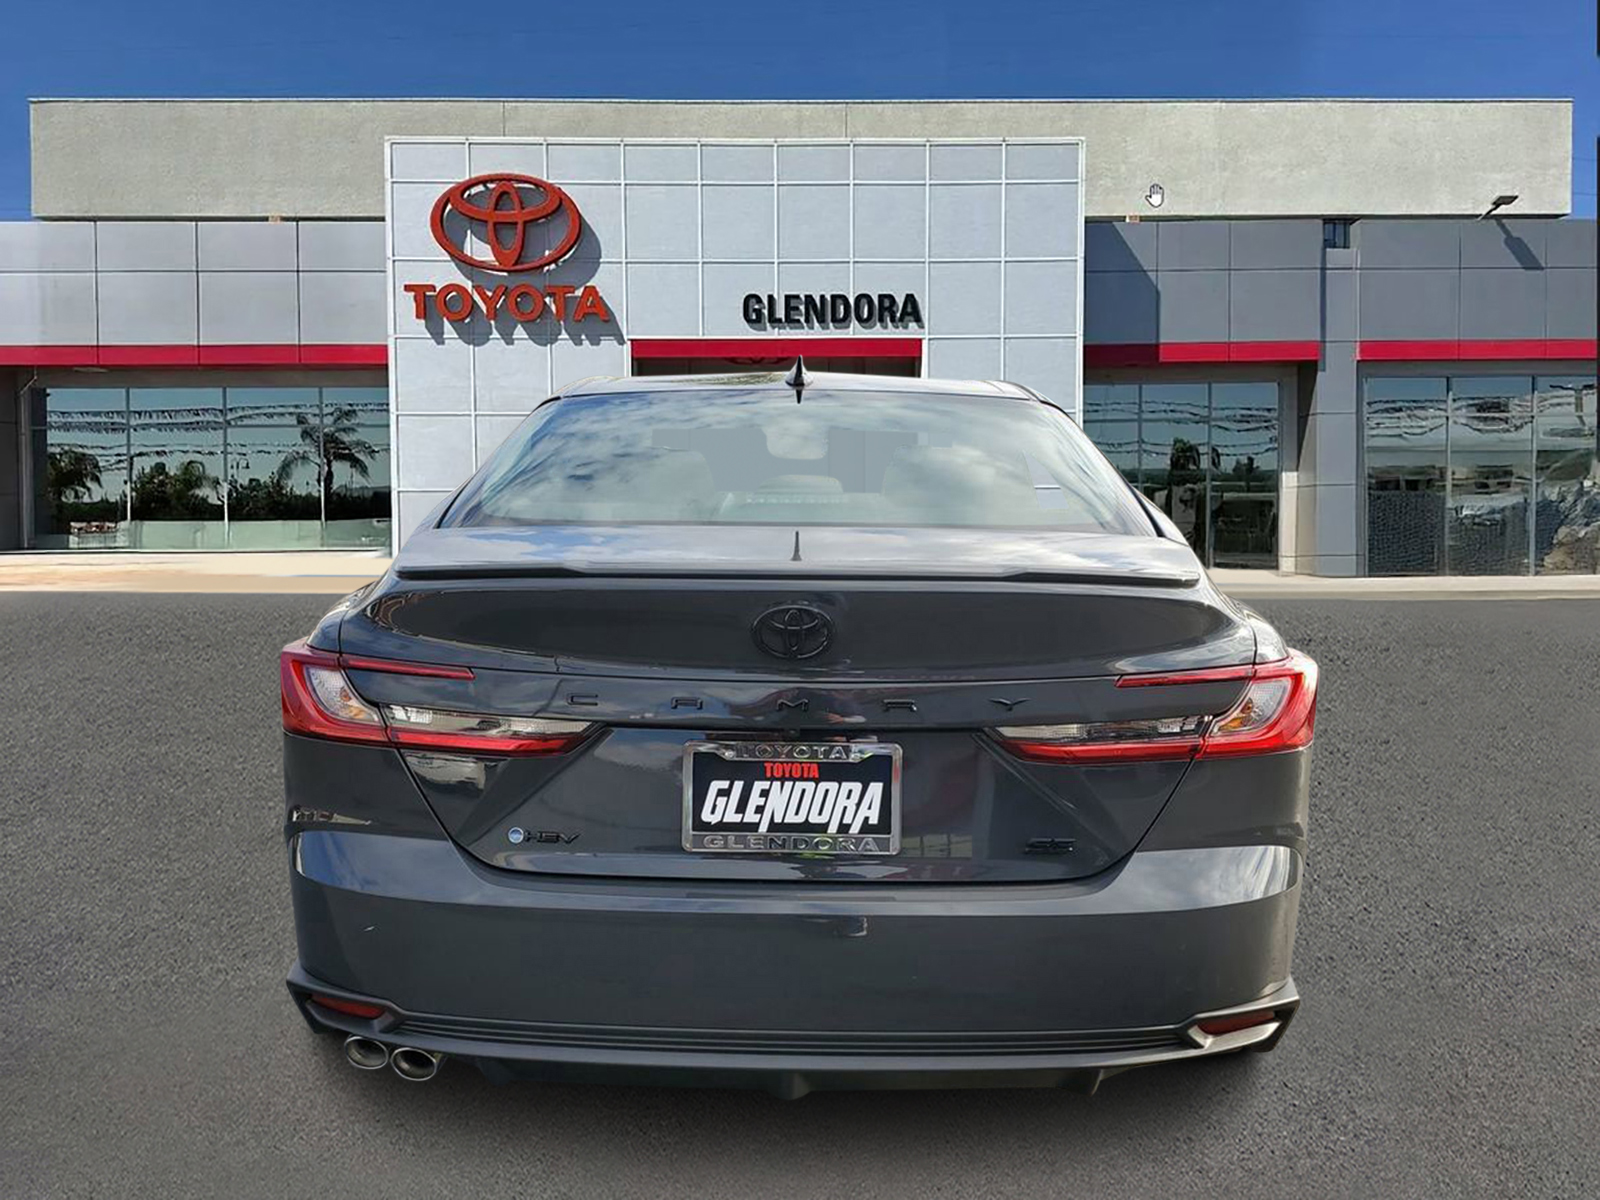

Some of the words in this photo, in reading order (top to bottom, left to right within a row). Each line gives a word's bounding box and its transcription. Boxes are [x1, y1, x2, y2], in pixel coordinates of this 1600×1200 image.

[404, 283, 610, 322] TOYOTA
[742, 294, 923, 324] GLENDORA
[738, 744, 848, 760] TOYOTA
[764, 762, 820, 779] TOYOTA
[700, 780, 884, 834] GLENDORA
[703, 835, 880, 851] GLENDORA
